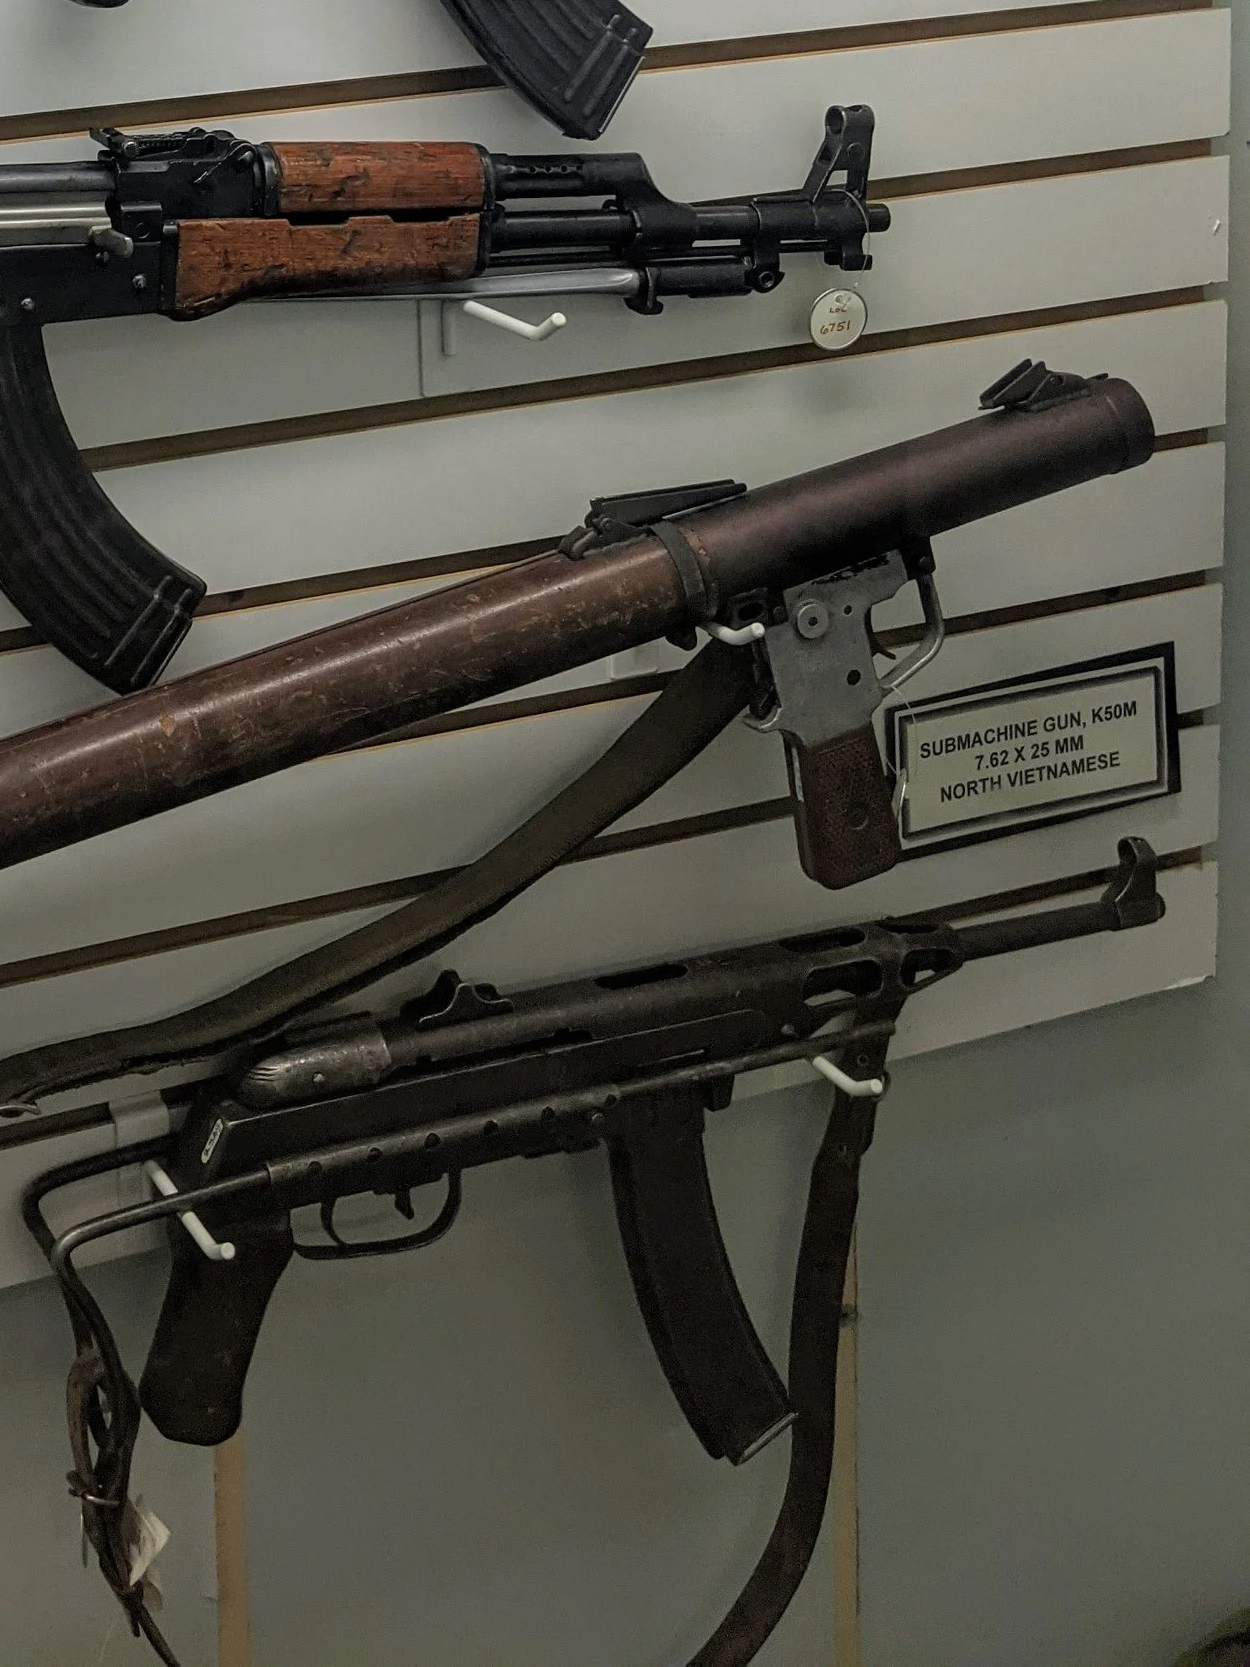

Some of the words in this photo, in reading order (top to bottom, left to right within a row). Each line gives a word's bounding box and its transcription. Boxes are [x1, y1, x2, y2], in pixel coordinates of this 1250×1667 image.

[820, 320, 851, 335] 6751
[920, 720, 1038, 758] SUBMACHINE
[1043, 712, 1087, 733] GUN,
[1092, 700, 1137, 724] K50M
[975, 749, 1008, 771] 7.62
[1014, 745, 1026, 763] X
[1031, 742, 1050, 759] 25
[1054, 735, 1084, 754] MM
[940, 774, 1002, 803] NORTH
[1006, 750, 1121, 788] VIETNAMESE
